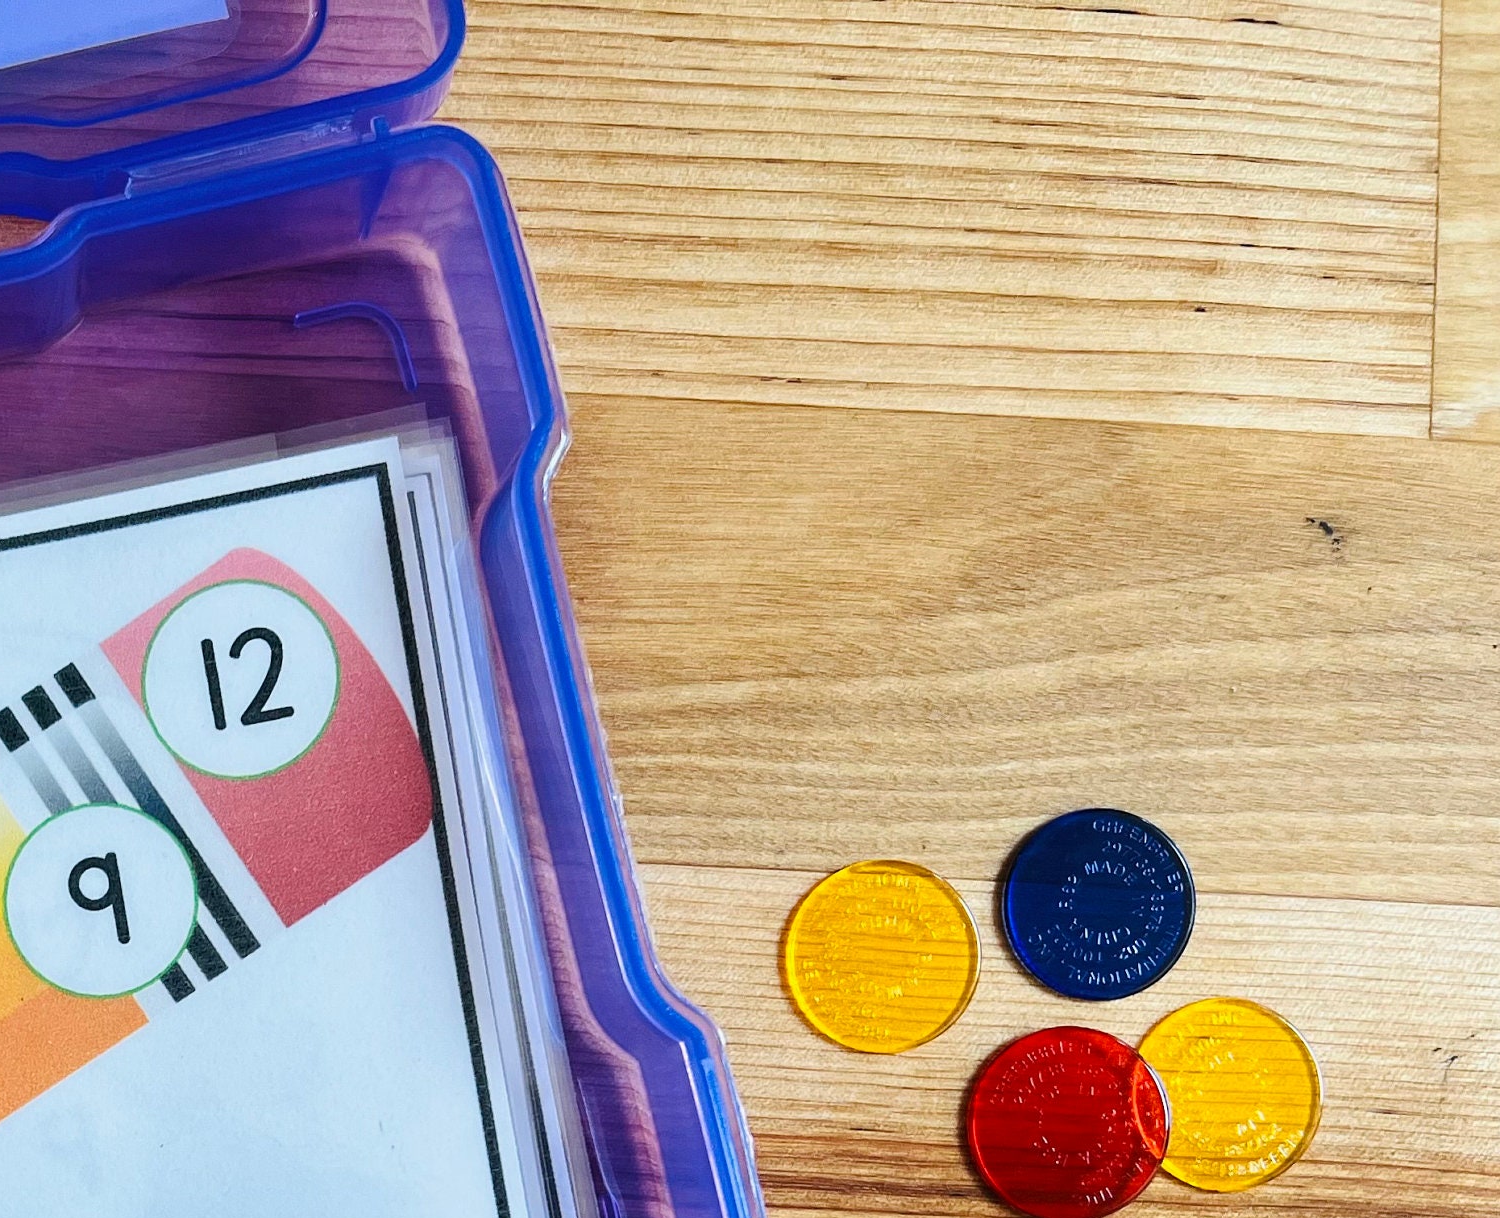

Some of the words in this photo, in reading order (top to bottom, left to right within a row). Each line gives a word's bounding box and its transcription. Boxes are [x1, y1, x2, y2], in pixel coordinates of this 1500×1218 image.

[200, 627, 295, 731] 12
[66, 852, 131, 945] 9
[1084, 860, 1137, 886] MADE
